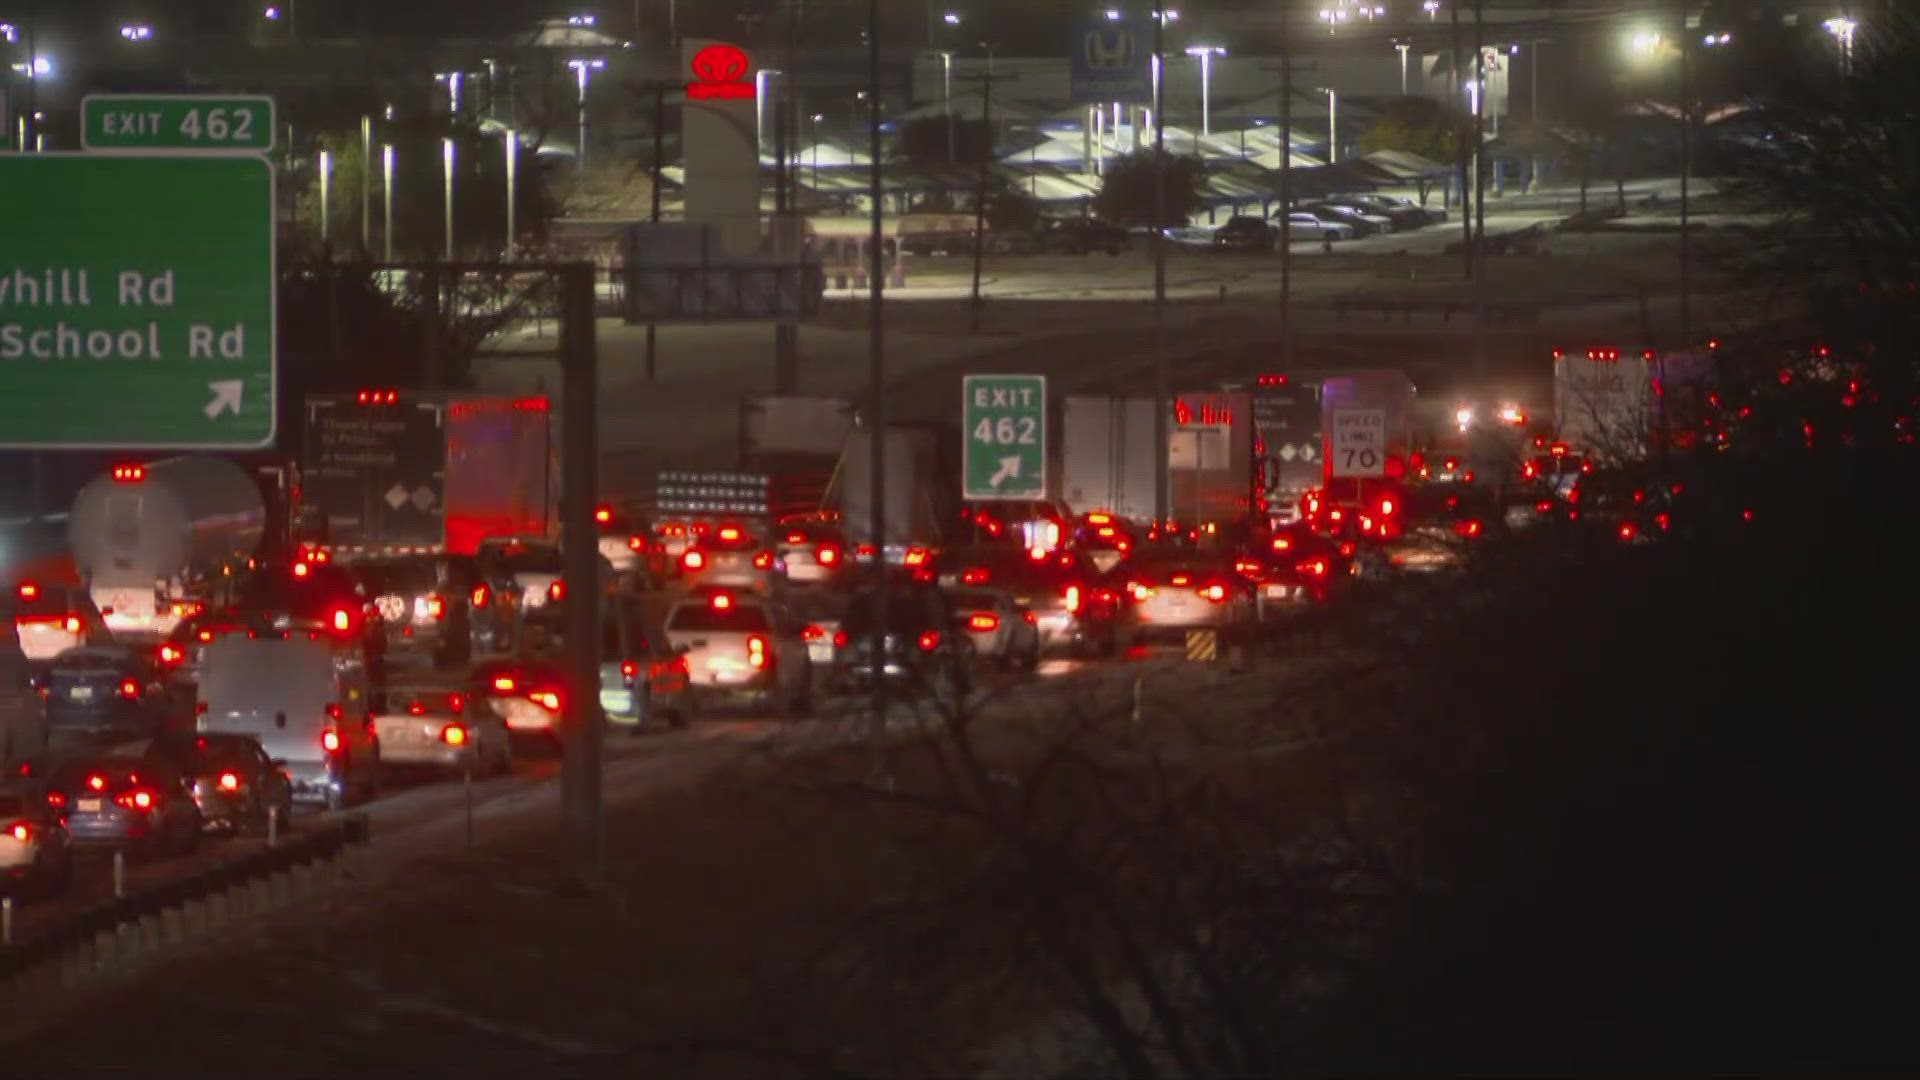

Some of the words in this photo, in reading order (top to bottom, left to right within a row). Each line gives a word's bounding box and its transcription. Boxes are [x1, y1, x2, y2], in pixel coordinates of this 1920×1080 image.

[103, 113, 162, 135] EXIT
[179, 108, 254, 140] 462
[118, 269, 175, 305] Rd
[0, 322, 162, 359] School
[188, 323, 244, 359] Rd
[975, 388, 1033, 408] EXIT
[974, 417, 1037, 444] 462
[1338, 415, 1382, 427] SPEED
[1342, 447, 1377, 469] 70
